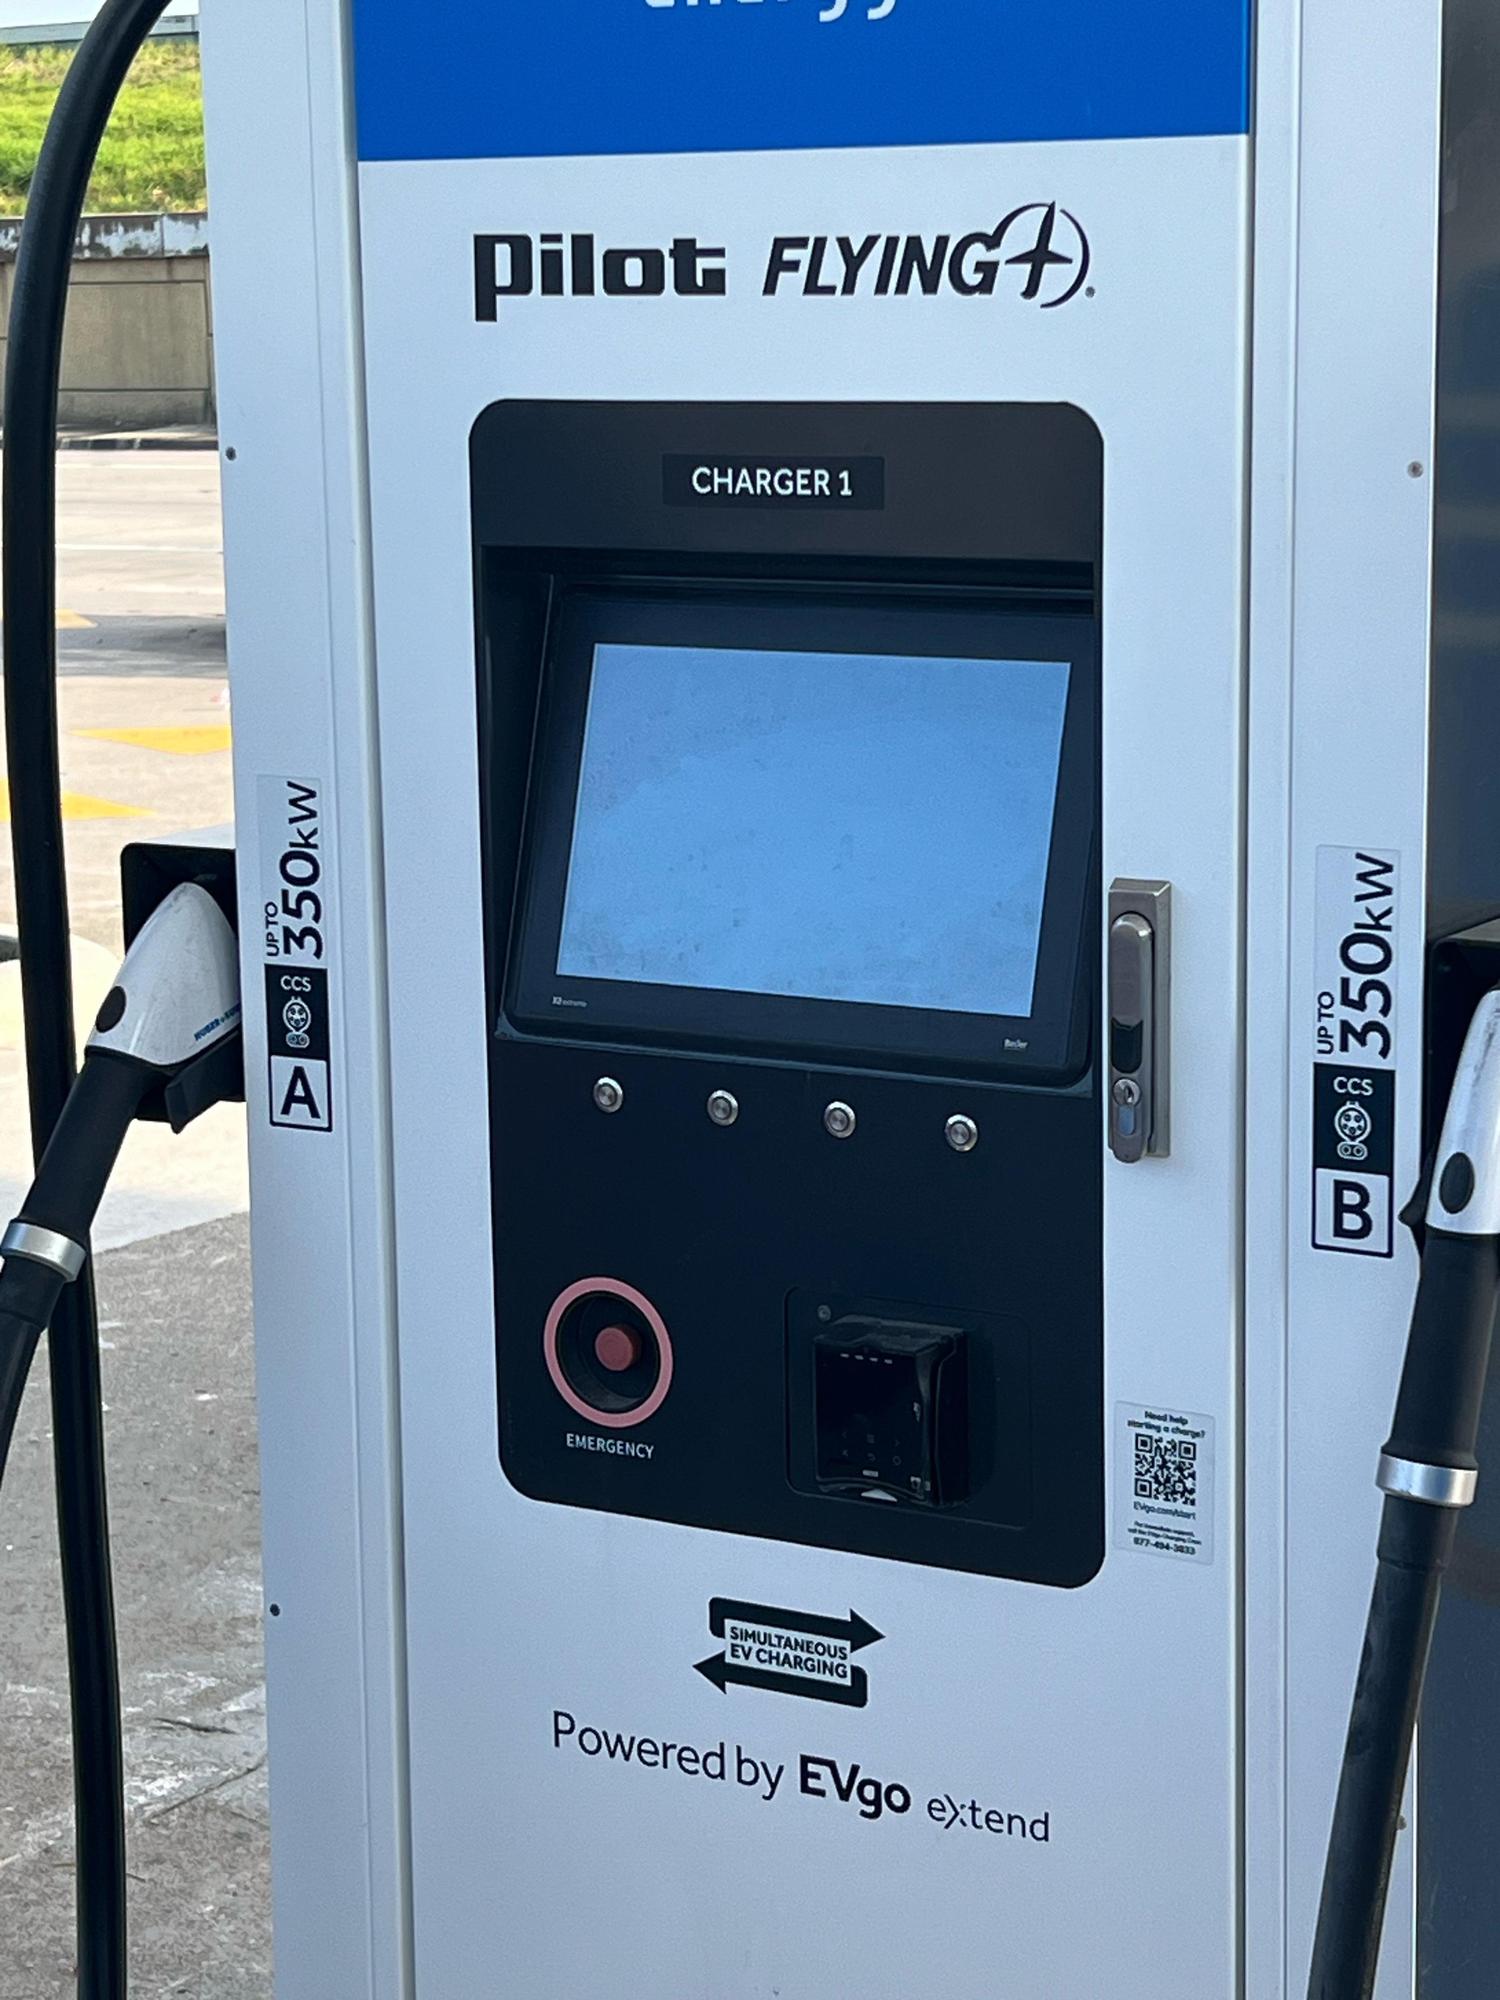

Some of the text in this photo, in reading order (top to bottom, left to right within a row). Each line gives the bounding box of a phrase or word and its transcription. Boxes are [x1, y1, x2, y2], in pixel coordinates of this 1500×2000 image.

[473, 233, 726, 323] pilot
[762, 231, 998, 297] FLYING
[692, 466, 852, 496] CHARGER 1
[278, 780, 323, 960] 350kW
[264, 901, 280, 957] UP TO
[1339, 852, 1394, 1060] 350kW
[280, 975, 312, 992] CCS
[1316, 991, 1335, 1055] UP TO
[280, 1065, 321, 1120] A
[1333, 1076, 1373, 1096] CCS
[1332, 1178, 1373, 1240] B
[1127, 1420, 1161, 1433] starting
[1171, 1426, 1205, 1439] charge?
[1144, 1411, 1188, 1426] Need help
[566, 1433, 655, 1459] EMERGENCY
[729, 1625, 849, 1661] SIMULTANEOUS
[729, 1643, 849, 1680] EV CHARGING
[552, 1710, 1050, 1843] Powered by EVgo extend
